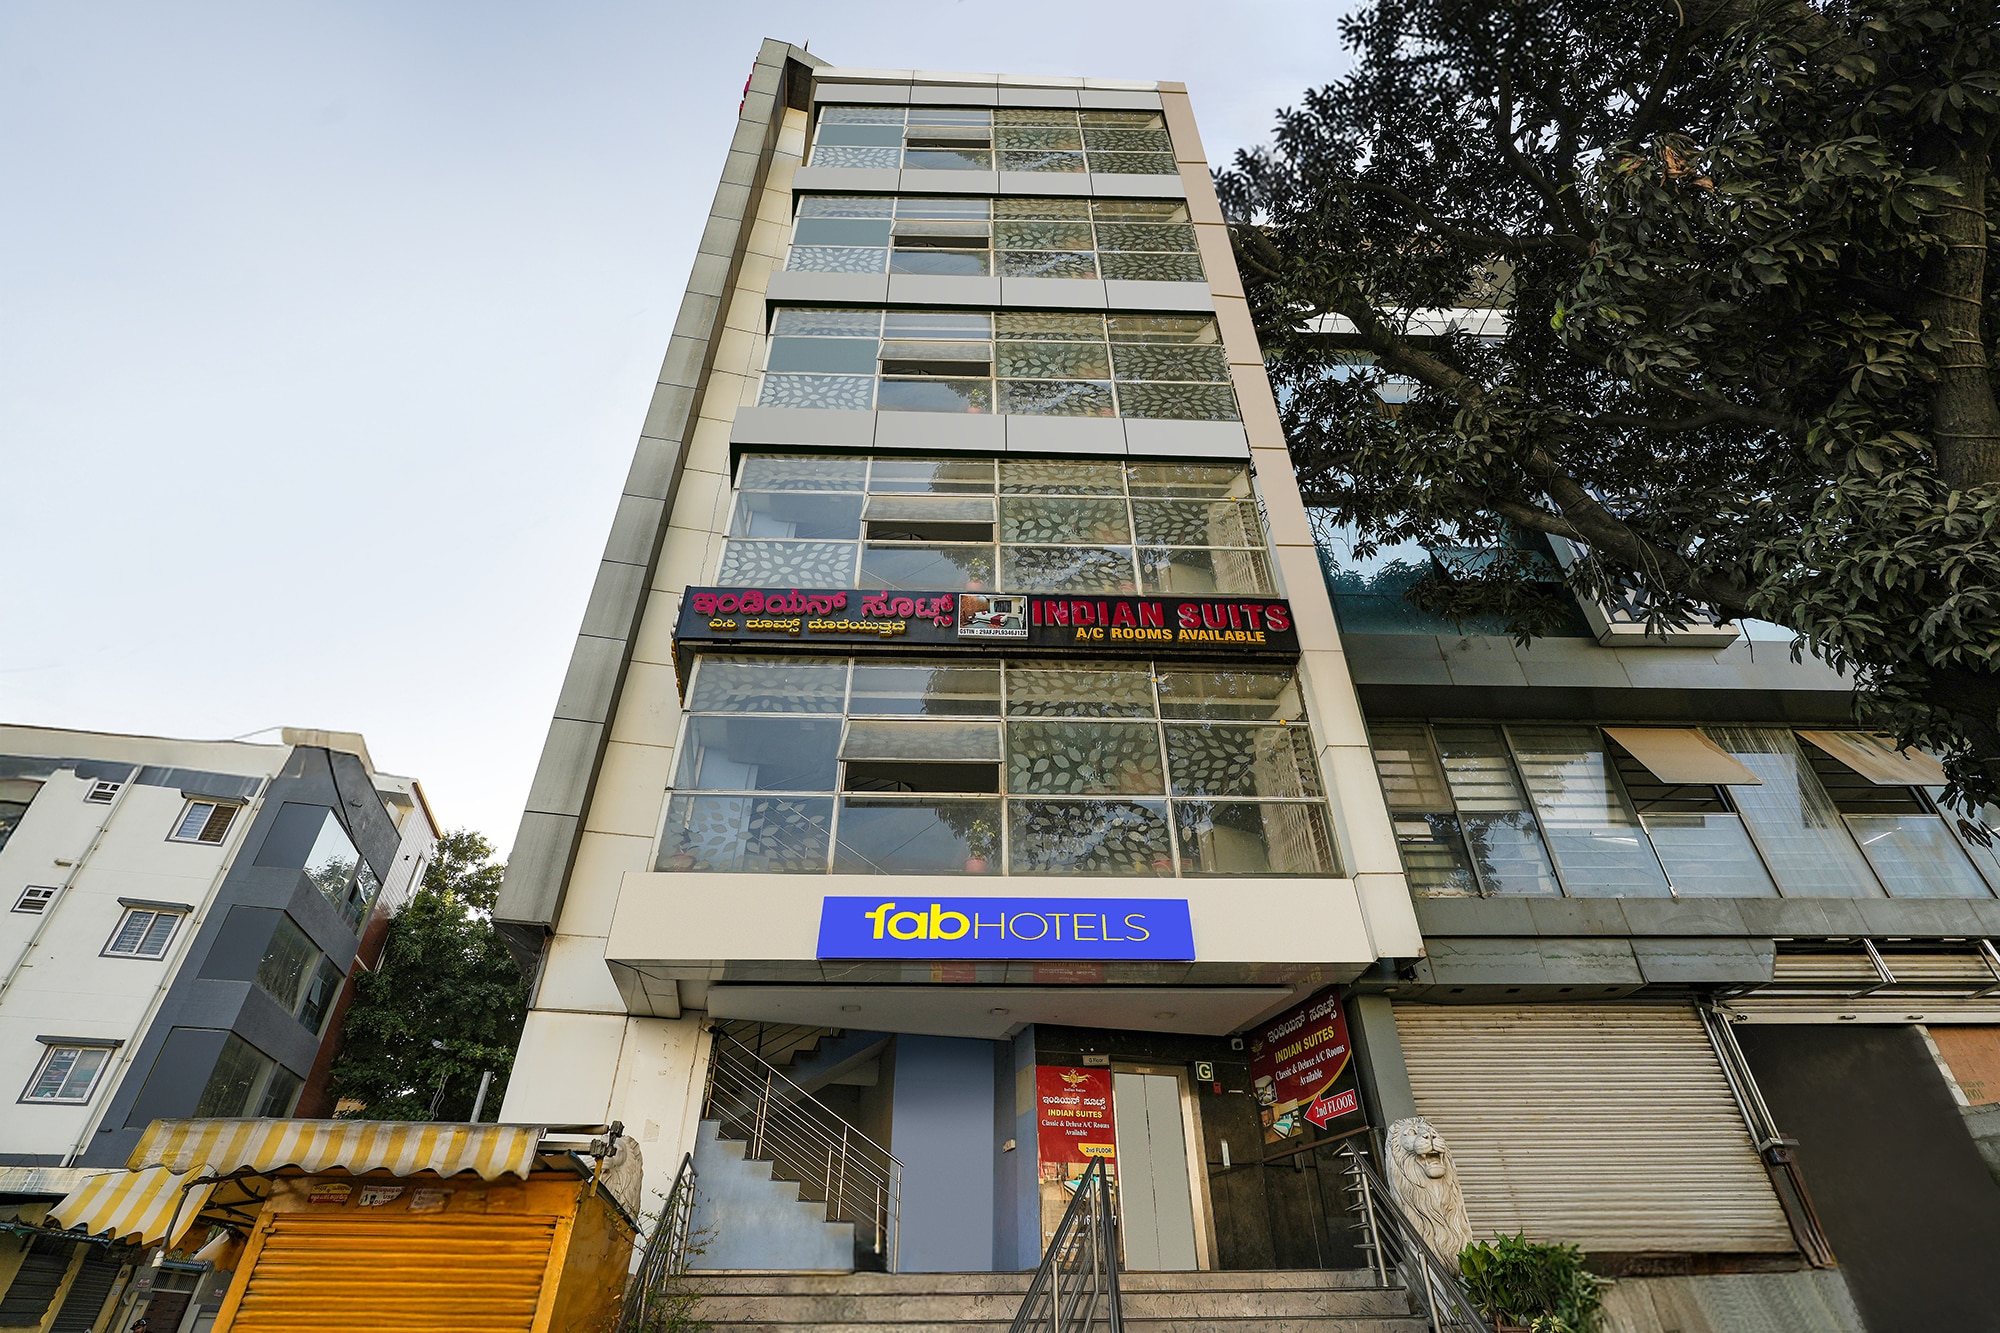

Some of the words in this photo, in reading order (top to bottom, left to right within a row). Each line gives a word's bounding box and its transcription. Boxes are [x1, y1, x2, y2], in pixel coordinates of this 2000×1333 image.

[692, 588, 847, 616] ಇಂಡಿಯನ್
[1031, 600, 1165, 627] INDIAN
[1177, 603, 1291, 632] SUITS
[1075, 626, 1104, 641] A/C
[1110, 628, 1173, 642] ROOMS
[1178, 629, 1267, 644] AVAILABLE
[1274, 1042, 1303, 1064] INDIAN
[1303, 1025, 1335, 1051] SUITES
[1198, 1064, 1211, 1079] G
[1275, 1066, 1292, 1082] Classic
[1292, 1063, 1298, 1072] &
[1297, 1057, 1315, 1072] Deluxe
[1315, 1050, 1326, 1064] A/C
[1326, 1044, 1346, 1060] Rooms
[1299, 1069, 1323, 1087] Available
[1047, 1109, 1074, 1117] INDIAN
[1076, 1110, 1103, 1118] SUITES
[1315, 1105, 1328, 1118] 2nd
[1328, 1094, 1355, 1114] FLOOR
